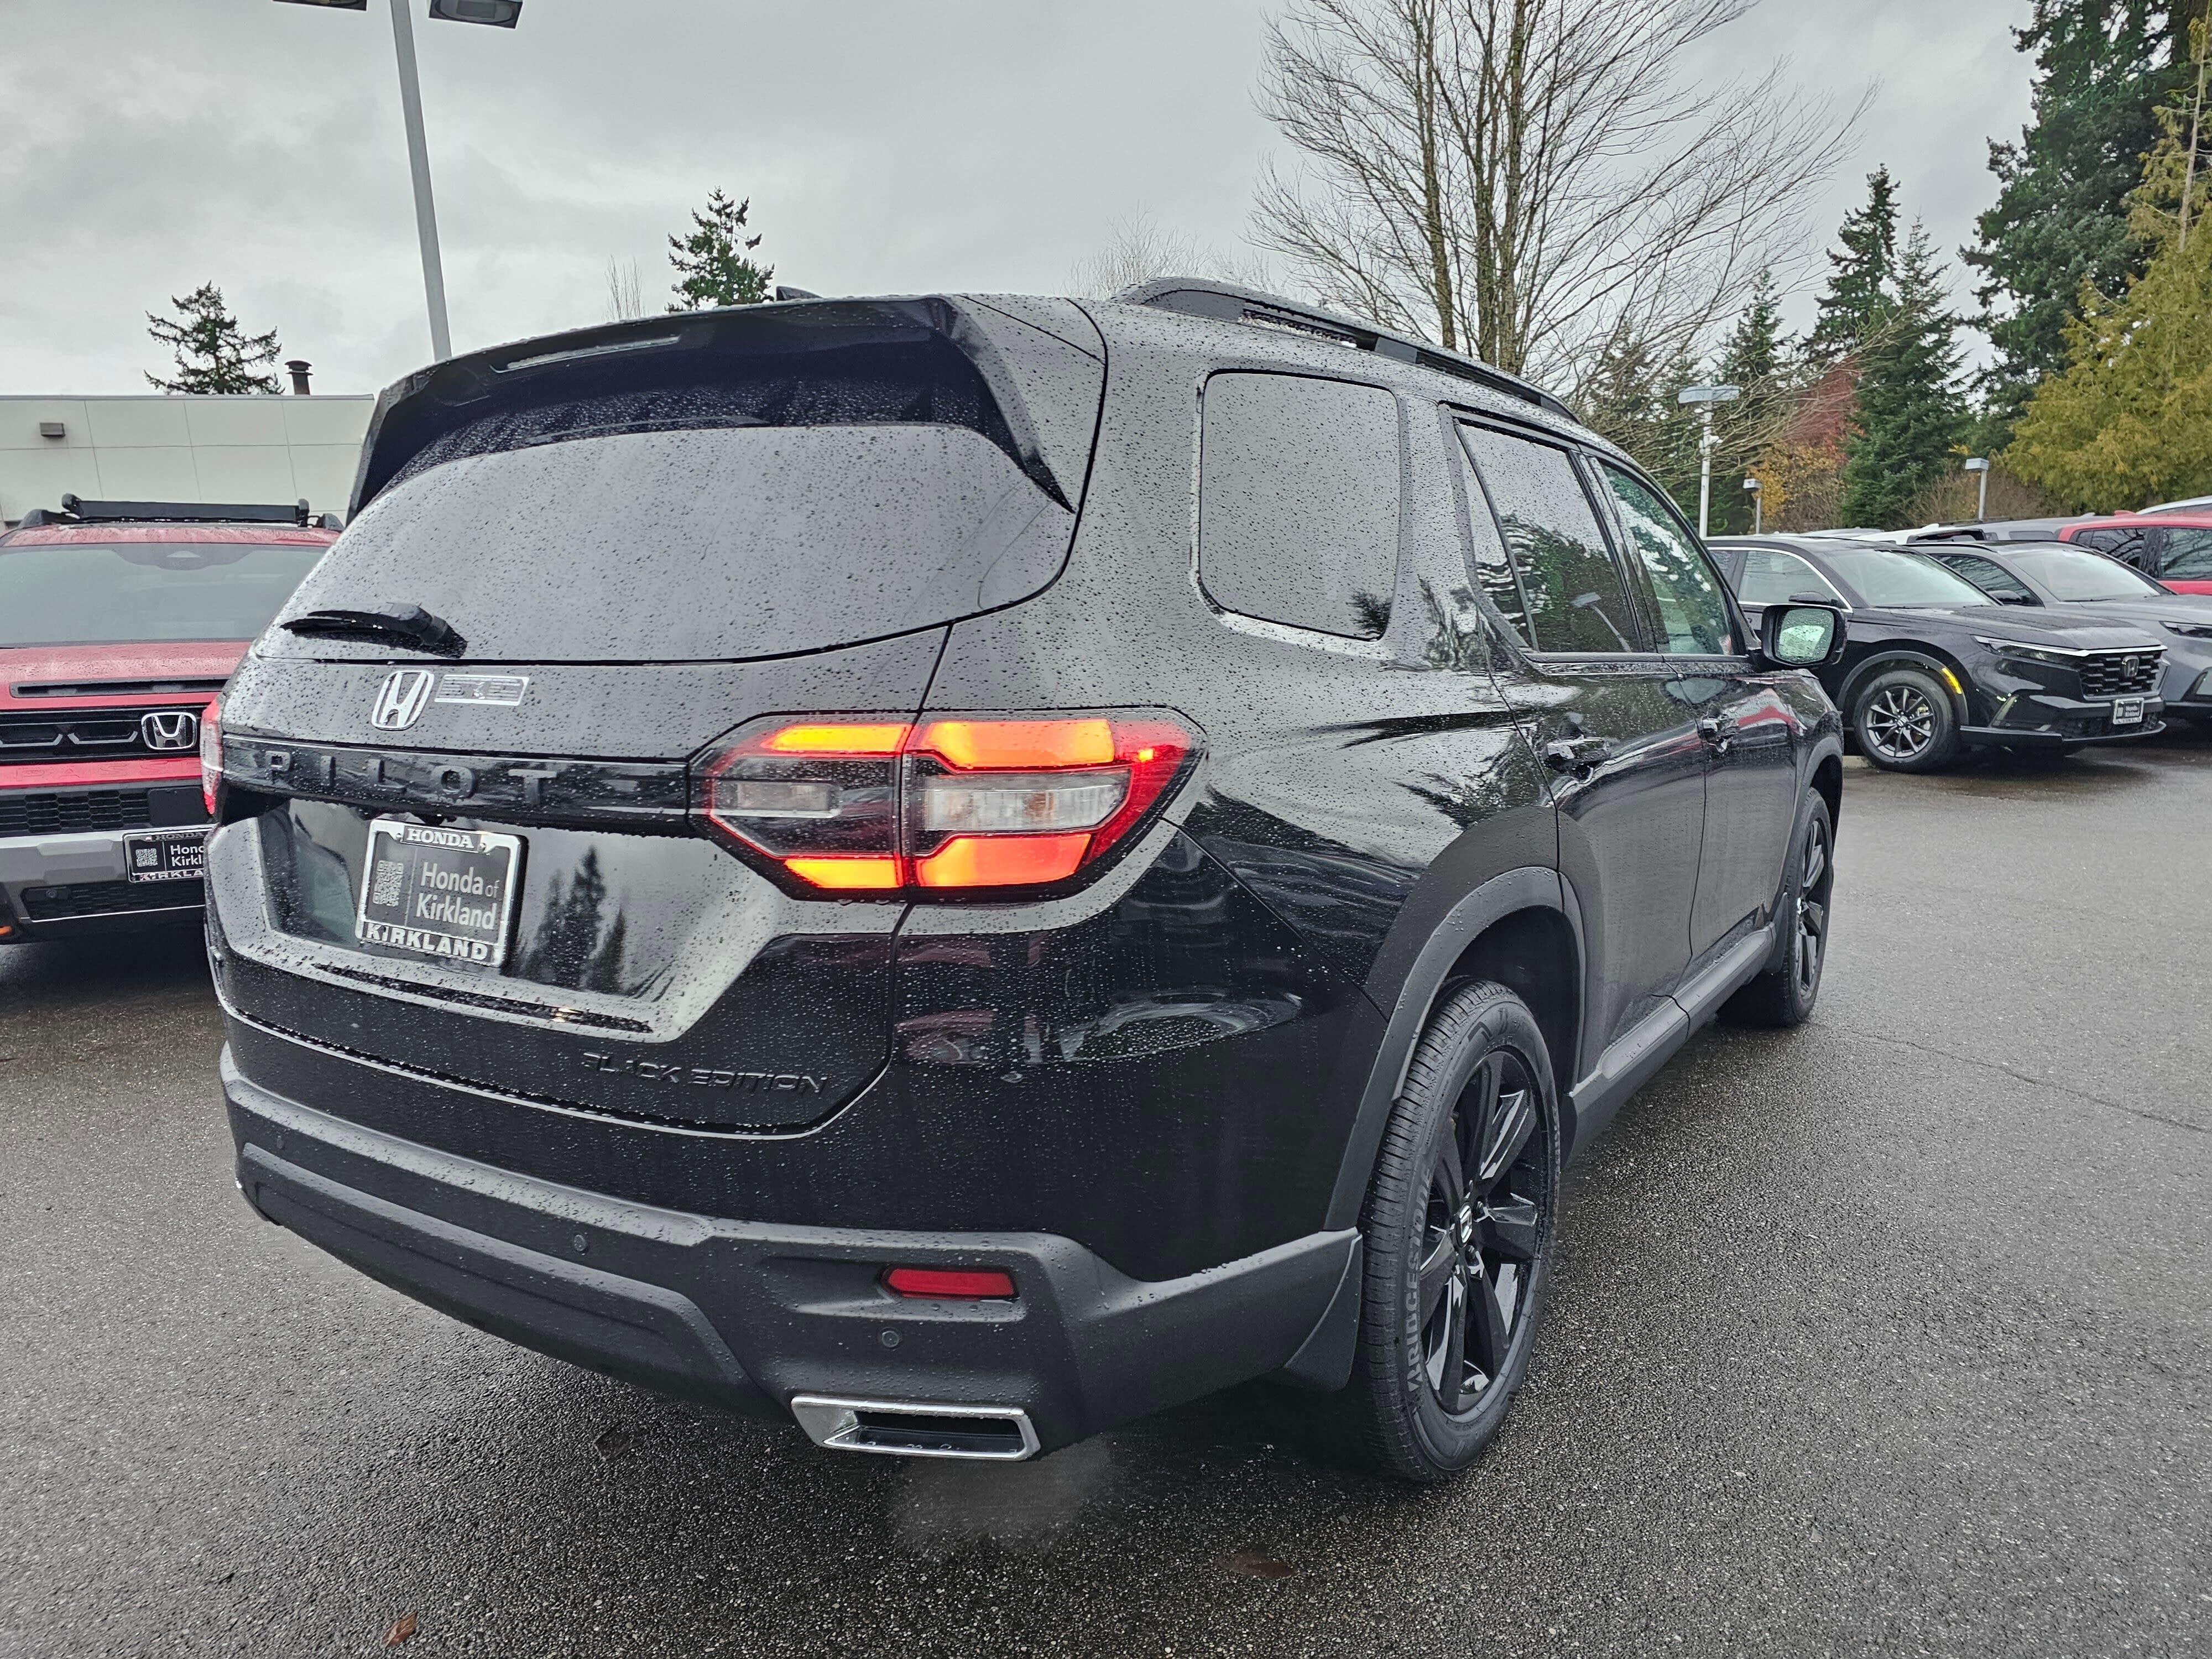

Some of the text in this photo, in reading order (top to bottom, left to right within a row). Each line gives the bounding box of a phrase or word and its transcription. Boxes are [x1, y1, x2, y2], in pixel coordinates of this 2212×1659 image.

[265, 750, 557, 805] PILOT
[155, 832, 204, 841] HONDA
[406, 828, 474, 849] HONDA
[171, 854, 202, 867] Kirkl
[420, 862, 500, 898] Honda of
[416, 892, 497, 930] Kirkland
[366, 923, 488, 961] KIRKLAND
[582, 1052, 828, 1094] BLACK EDITION
[1406, 1166, 1433, 1392] BRIDGESTONE
